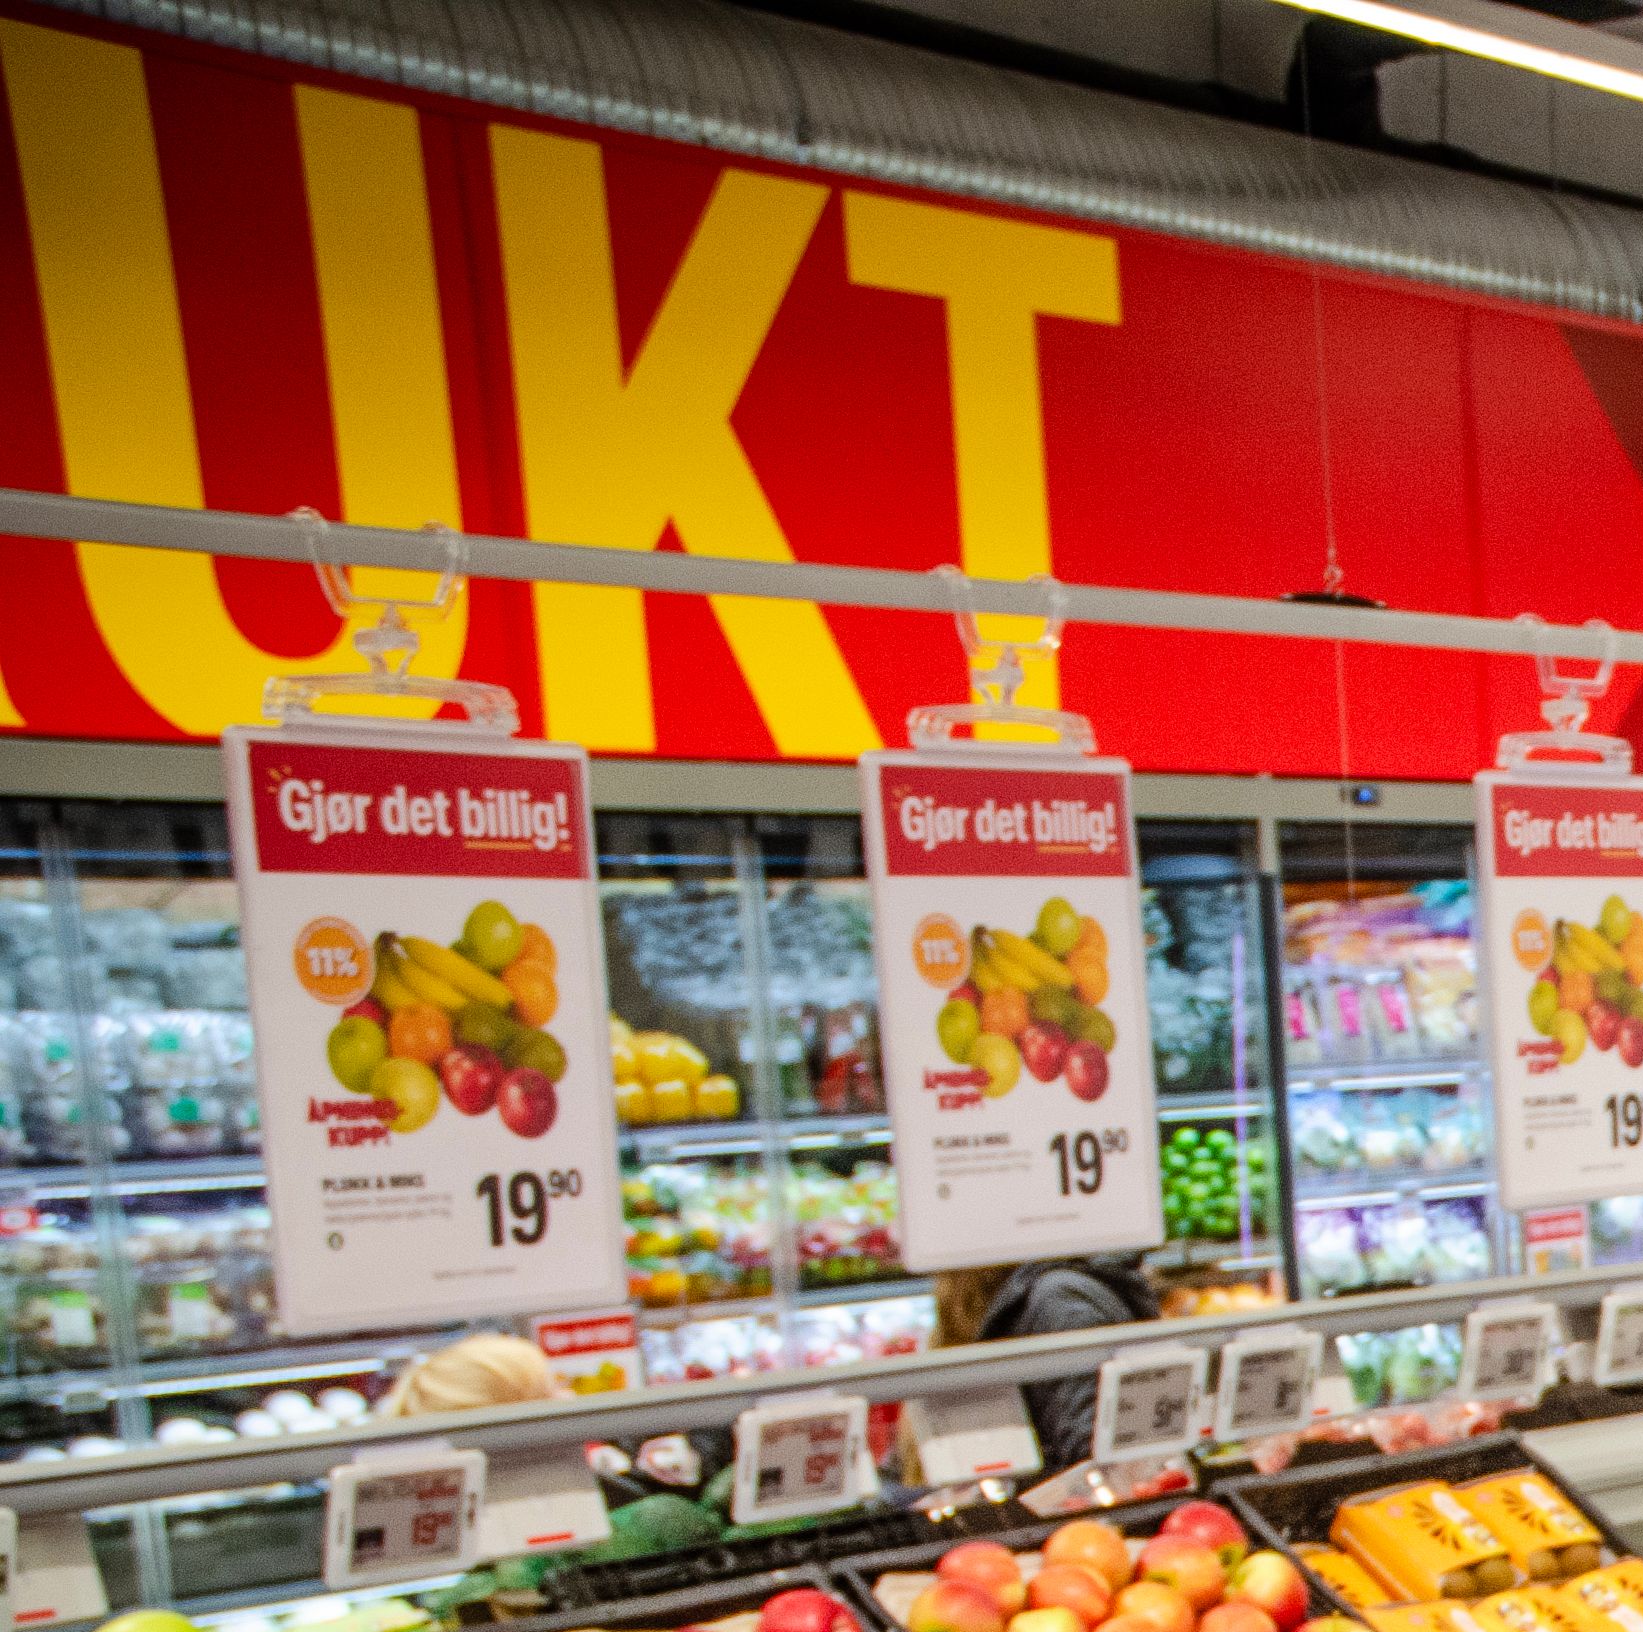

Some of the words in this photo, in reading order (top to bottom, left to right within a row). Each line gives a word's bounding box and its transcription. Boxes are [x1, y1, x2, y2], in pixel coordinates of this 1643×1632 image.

[278, 778, 372, 844] Gjør
[380, 785, 453, 837] det
[459, 787, 572, 850] billig!
[901, 796, 970, 852] Gjør
[975, 799, 1030, 843] det
[1031, 800, 1118, 853] billig!
[1504, 809, 1554, 857] Gjør
[1555, 811, 1596, 849] det
